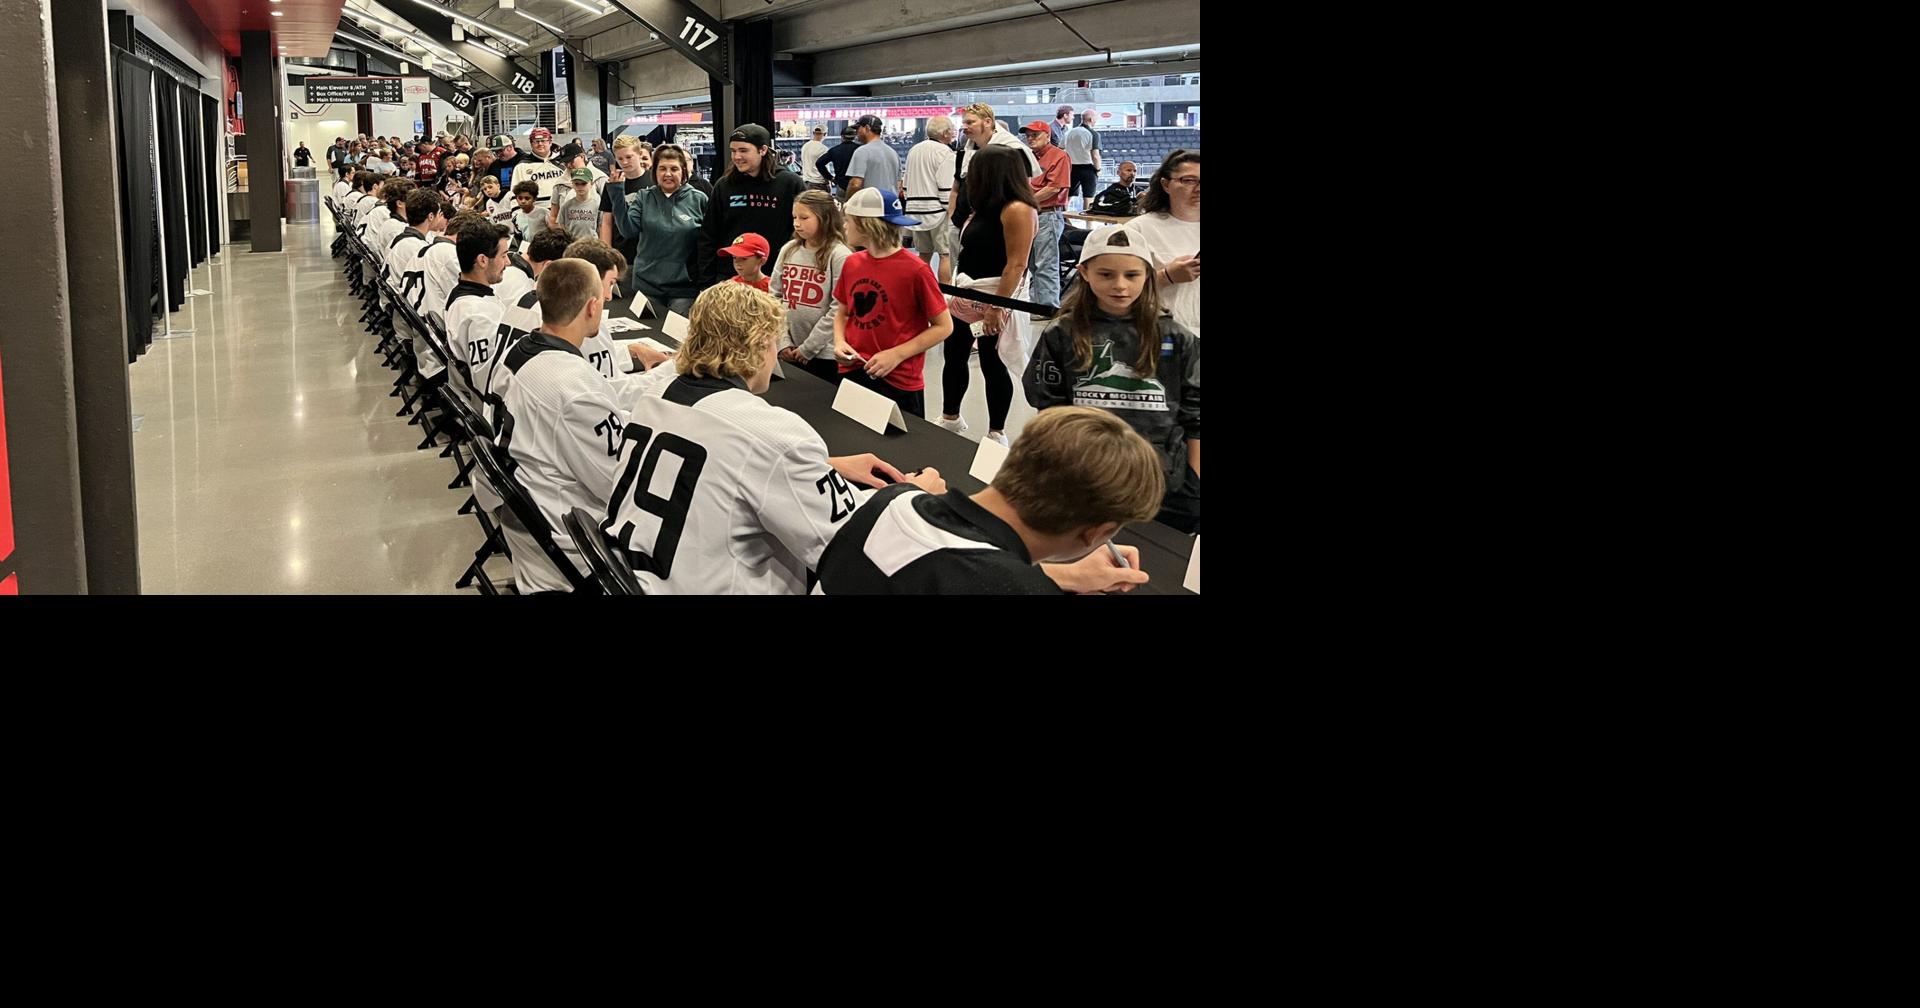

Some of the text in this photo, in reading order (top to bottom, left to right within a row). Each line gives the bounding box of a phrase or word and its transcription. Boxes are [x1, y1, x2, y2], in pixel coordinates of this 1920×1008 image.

[679, 16, 719, 51] 117
[511, 72, 535, 94] 118
[452, 92, 470, 108] 119
[782, 265, 826, 284] GO BIG
[782, 278, 824, 305] RED
[468, 338, 489, 366] 26
[1076, 391, 1164, 402] ROCKY MOUNTAIN
[600, 422, 708, 580] 29
[816, 467, 857, 523] 29
